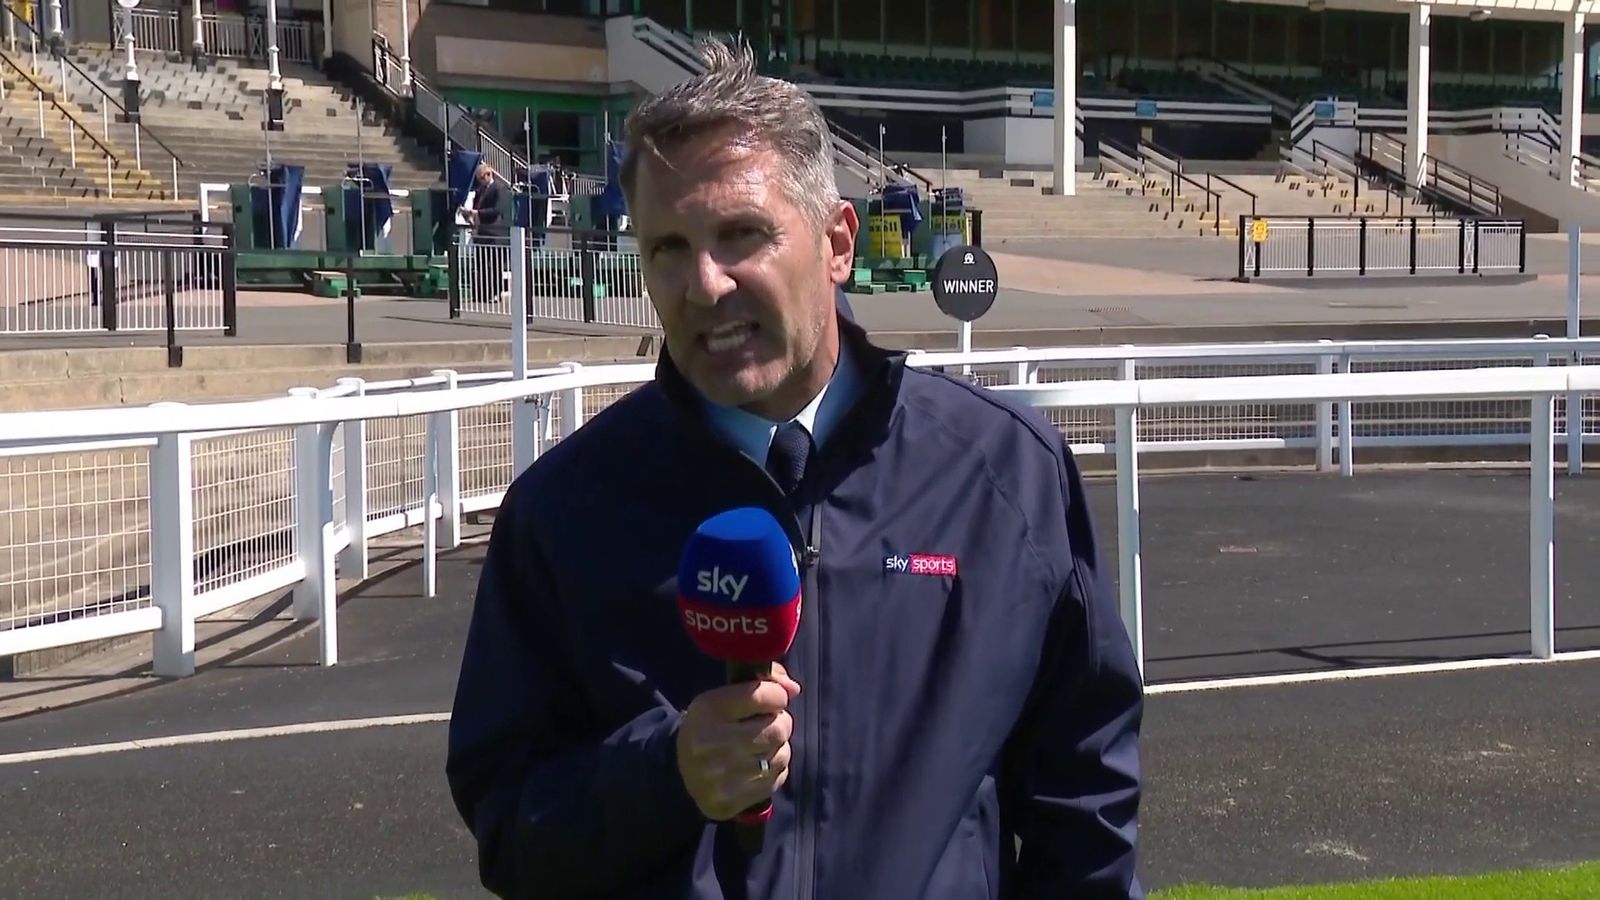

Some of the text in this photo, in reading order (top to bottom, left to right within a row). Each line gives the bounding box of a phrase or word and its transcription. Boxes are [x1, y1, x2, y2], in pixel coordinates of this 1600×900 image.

[943, 279, 994, 294] WINNER
[886, 555, 953, 573] sky sports
[697, 565, 749, 602] sky
[684, 609, 769, 634] sports
